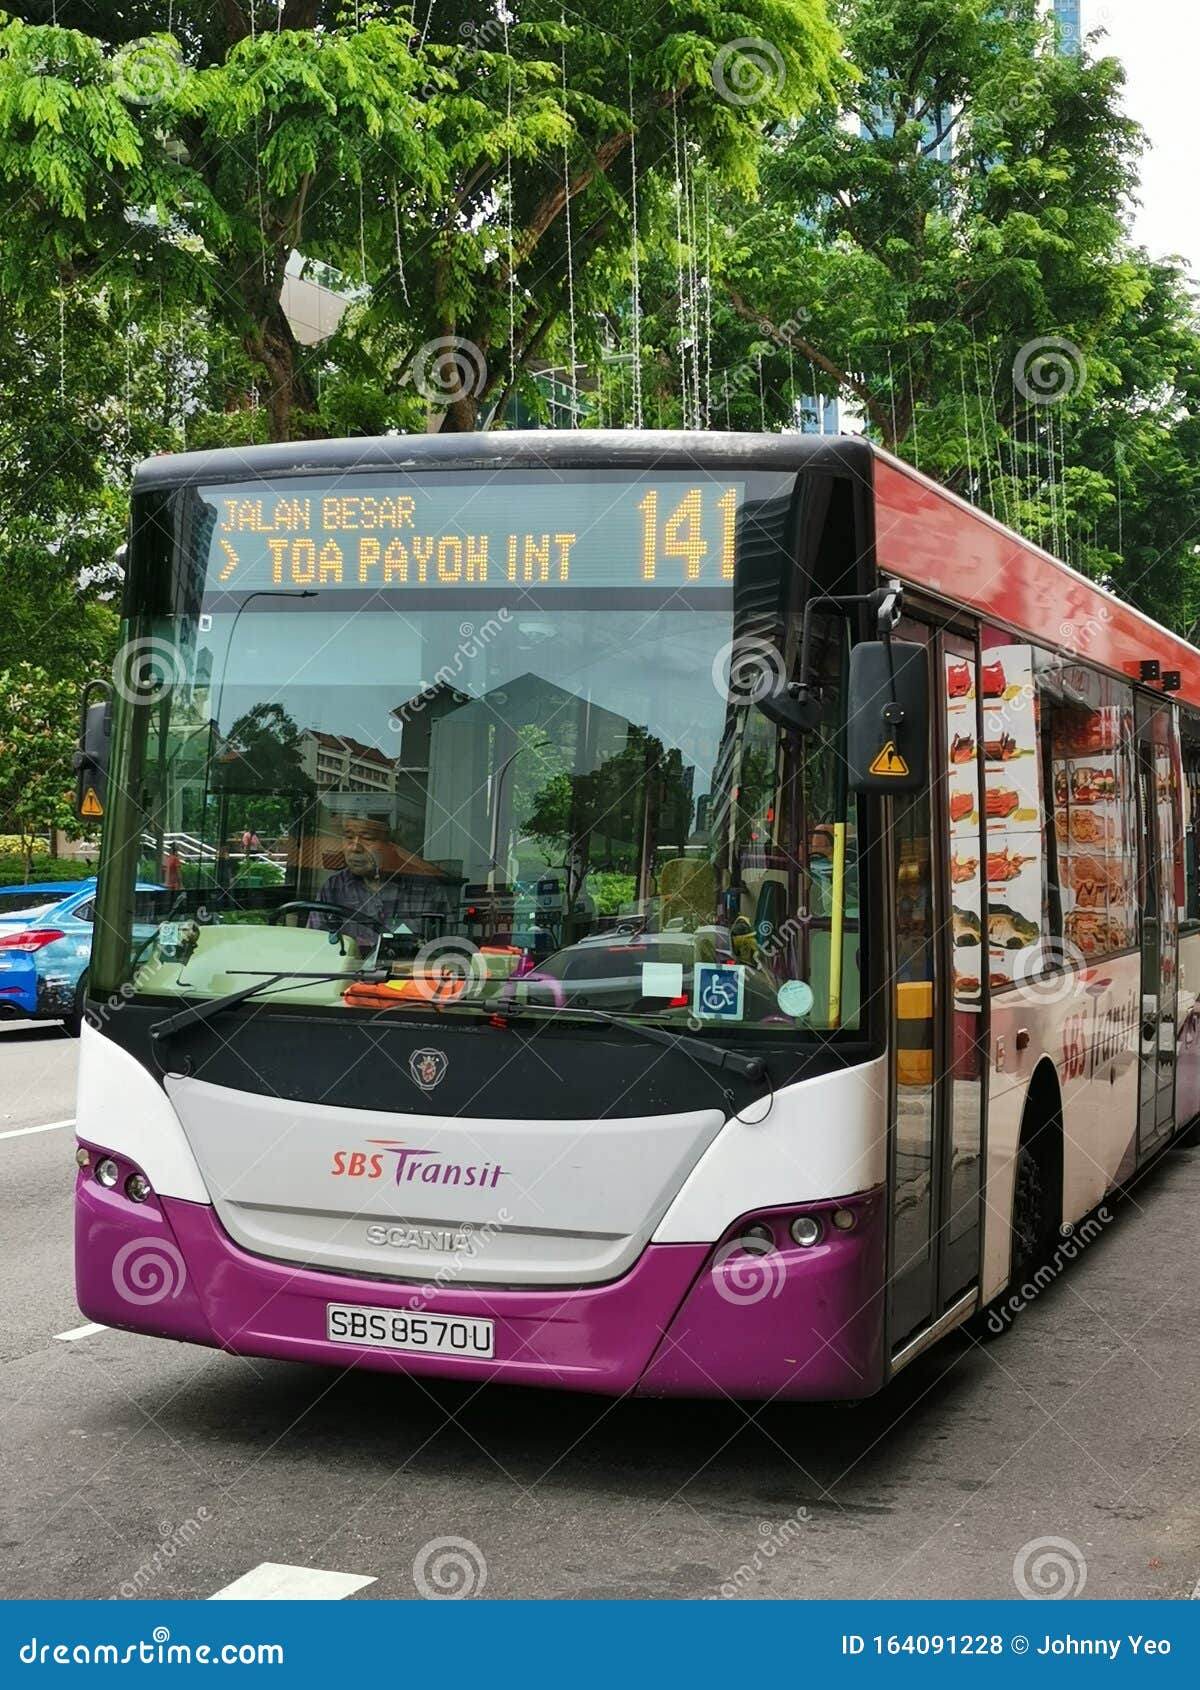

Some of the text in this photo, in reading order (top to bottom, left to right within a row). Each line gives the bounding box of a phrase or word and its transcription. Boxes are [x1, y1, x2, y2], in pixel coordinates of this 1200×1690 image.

[220, 495, 416, 532] JALAN BESAR
[637, 487, 737, 580] 141
[268, 533, 577, 585] TOA PAYOH INT
[331, 1148, 512, 1188] SBS Transit
[366, 1224, 474, 1254] SCANIA
[331, 1310, 491, 1351] SBS8570U
